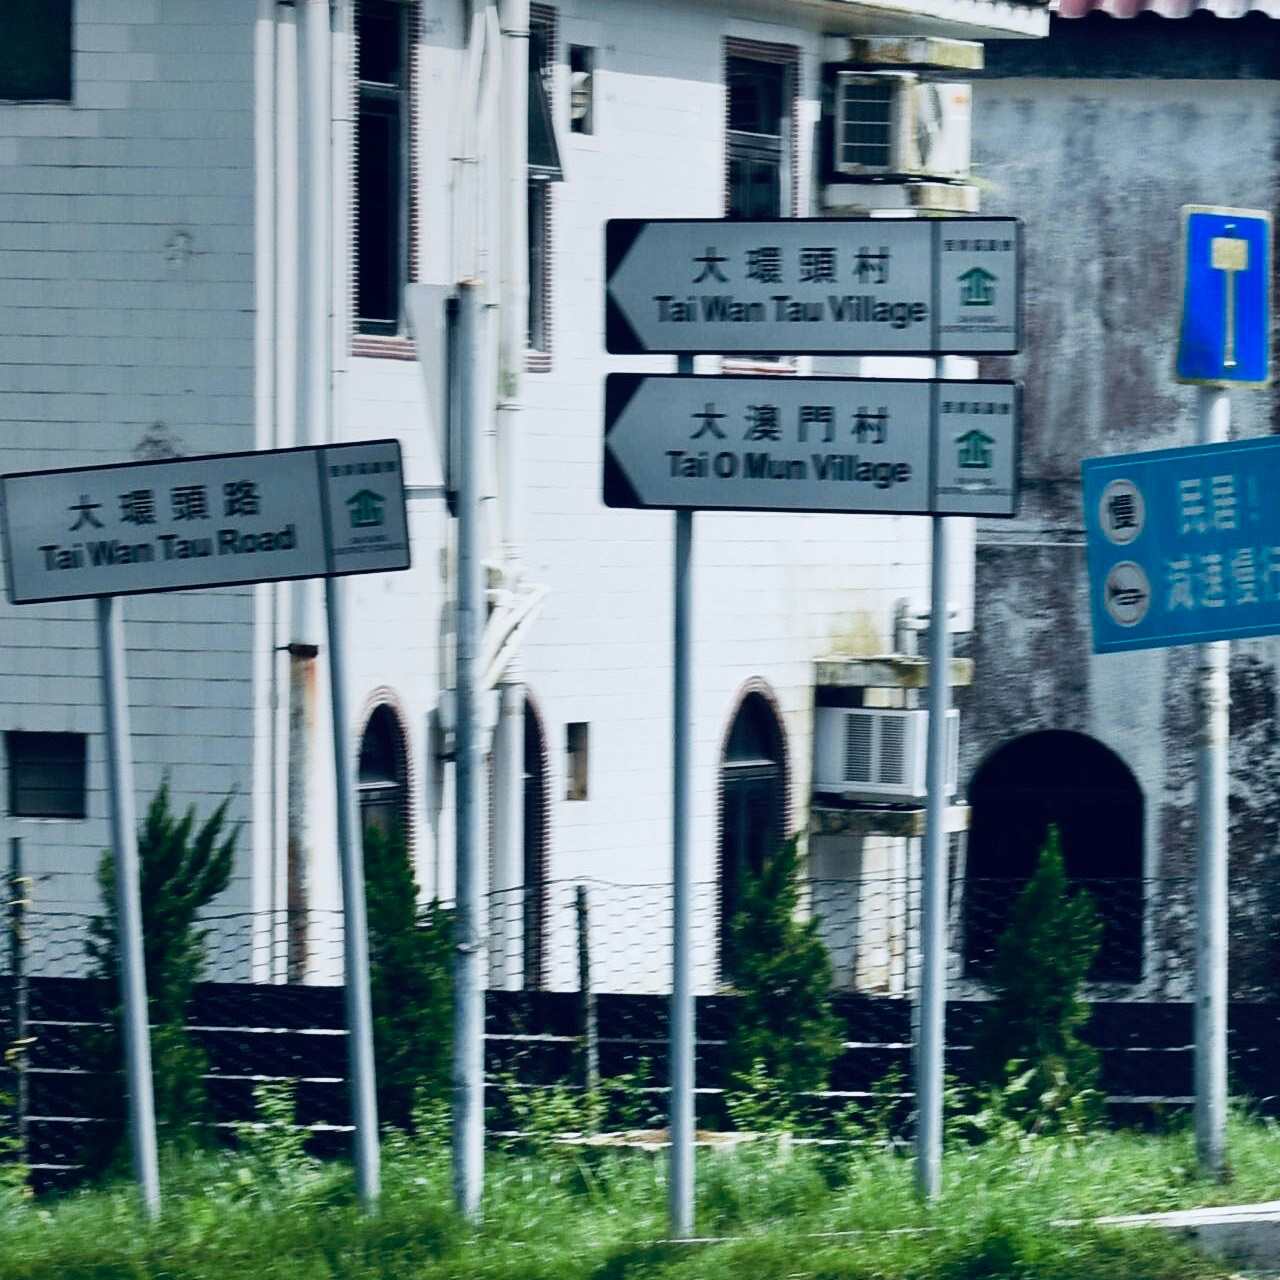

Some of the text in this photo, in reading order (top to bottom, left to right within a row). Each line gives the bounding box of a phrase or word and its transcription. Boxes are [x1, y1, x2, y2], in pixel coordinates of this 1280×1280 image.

[653, 296, 695, 322] Tai
[702, 296, 766, 322] Wan
[771, 296, 824, 322] Tau
[829, 296, 929, 330] Village
[665, 450, 708, 478] Tai
[714, 452, 738, 478] O
[743, 452, 806, 480] Mun
[811, 454, 912, 490] Village
[37, 524, 297, 571] Tai Wan Tau Road
